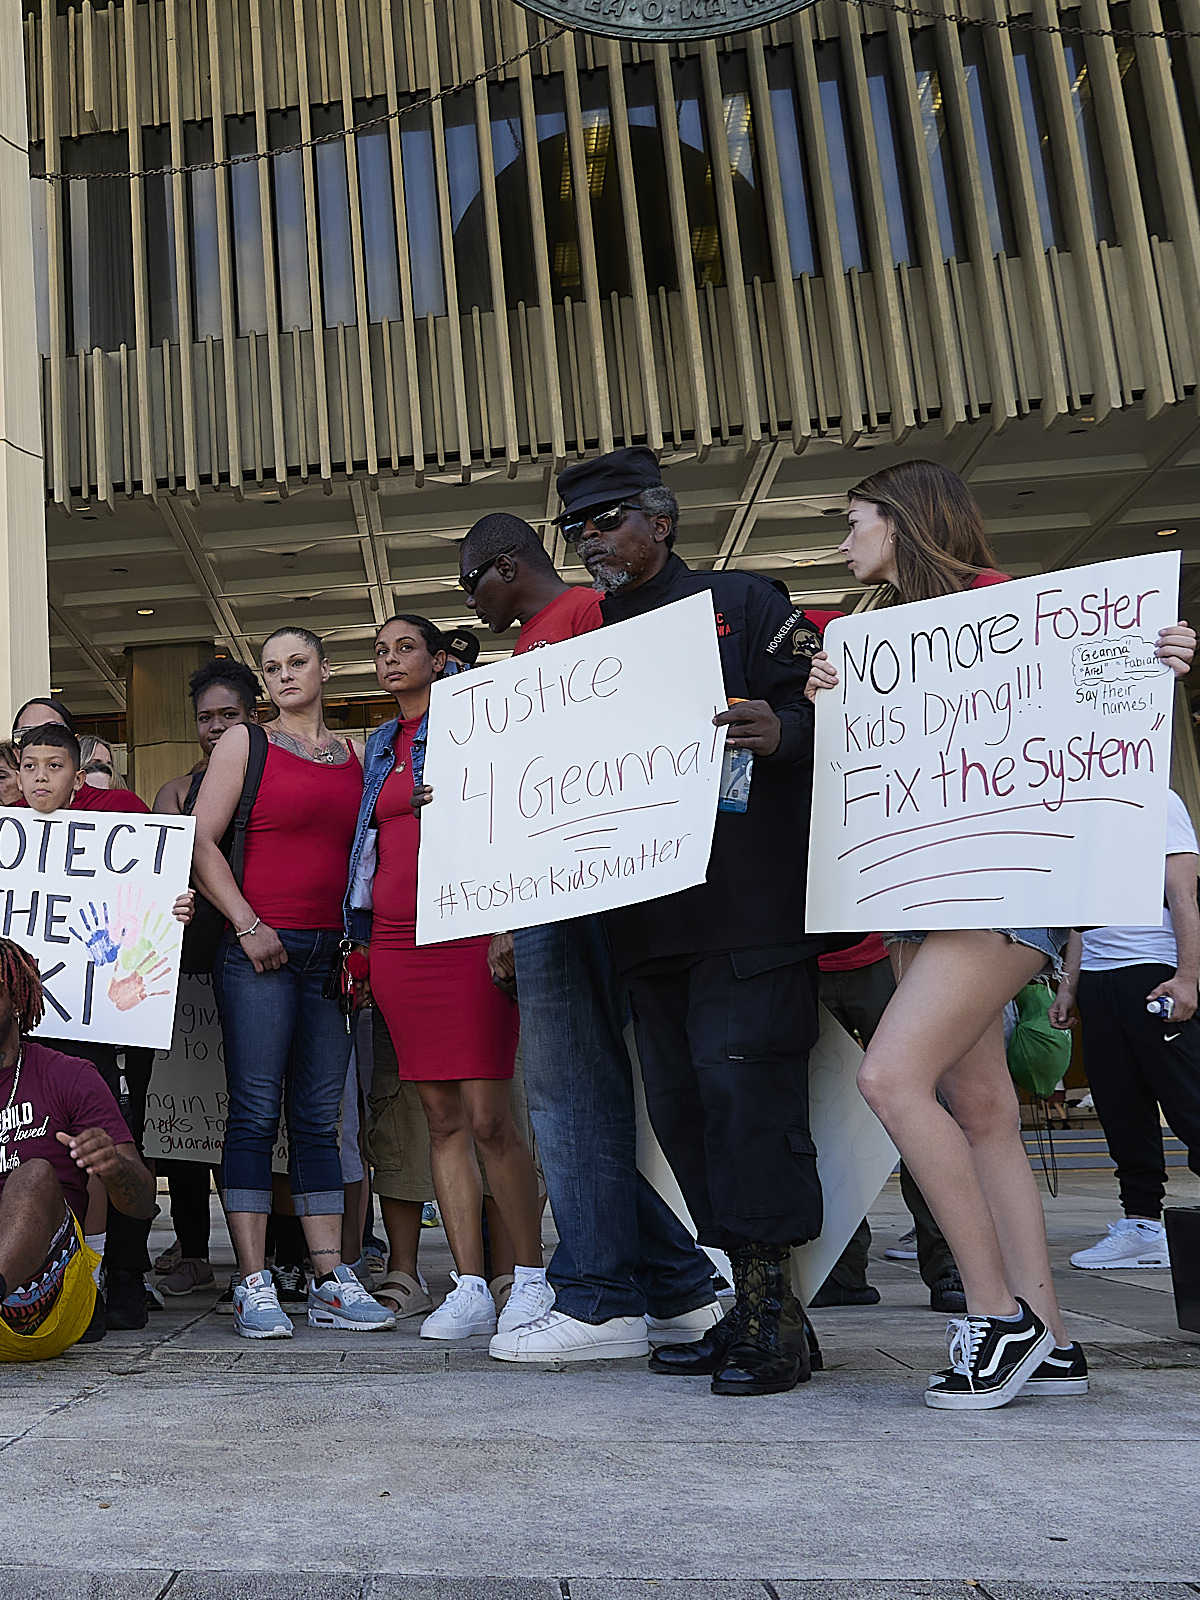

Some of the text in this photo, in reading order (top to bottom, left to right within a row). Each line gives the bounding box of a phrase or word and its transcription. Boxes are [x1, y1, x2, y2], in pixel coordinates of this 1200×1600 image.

[910, 612, 1024, 684] more
[1034, 587, 1161, 646] Foster
[923, 663, 1044, 756] Dying!!!
[1075, 683, 1137, 710] Say their
[1102, 692, 1154, 716] names!
[931, 747, 1016, 808] the
[461, 761, 495, 845] 4
[184, 1036, 208, 1060] to
[147, 1093, 175, 1122] ng
[182, 1094, 206, 1114] in
[13, 1115, 50, 1142] loved
[160, 1135, 225, 1154] guardia
